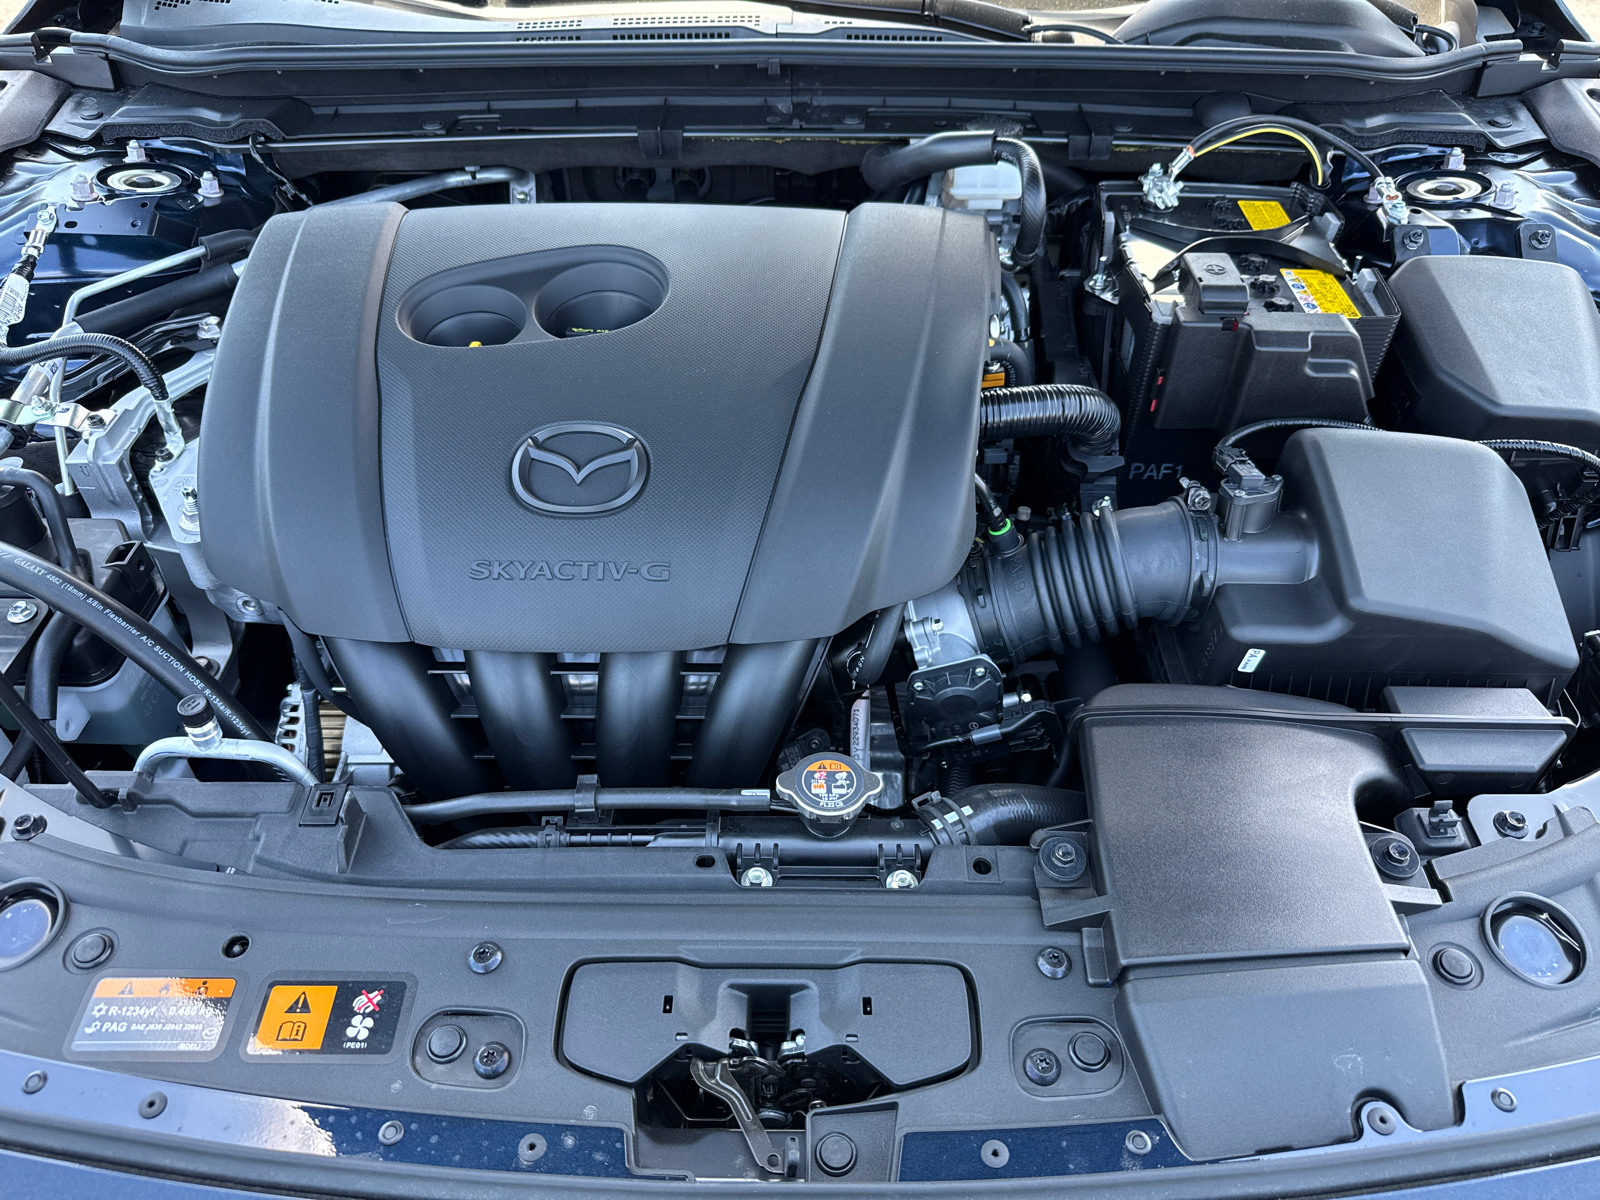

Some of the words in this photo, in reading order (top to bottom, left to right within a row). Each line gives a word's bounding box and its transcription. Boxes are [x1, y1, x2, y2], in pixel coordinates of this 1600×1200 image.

[1128, 462, 1183, 480] PAF1
[468, 560, 671, 582] SKYACTIV-G
[14, 558, 48, 576] GALAXY
[61, 582, 87, 600] (16mm)
[86, 597, 104, 611] 5/8in
[103, 608, 141, 637] Flexbarrier
[140, 635, 155, 647] A/C
[153, 644, 186, 673] SUCTION
[184, 670, 205, 690] HOSE
[108, 1005, 157, 1018] R-1234yf
[168, 1006, 199, 1016] 0.480
[102, 1021, 128, 1033] PAG
[130, 1023, 146, 1031] SAE
[342, 1041, 368, 1050] (PE01)
